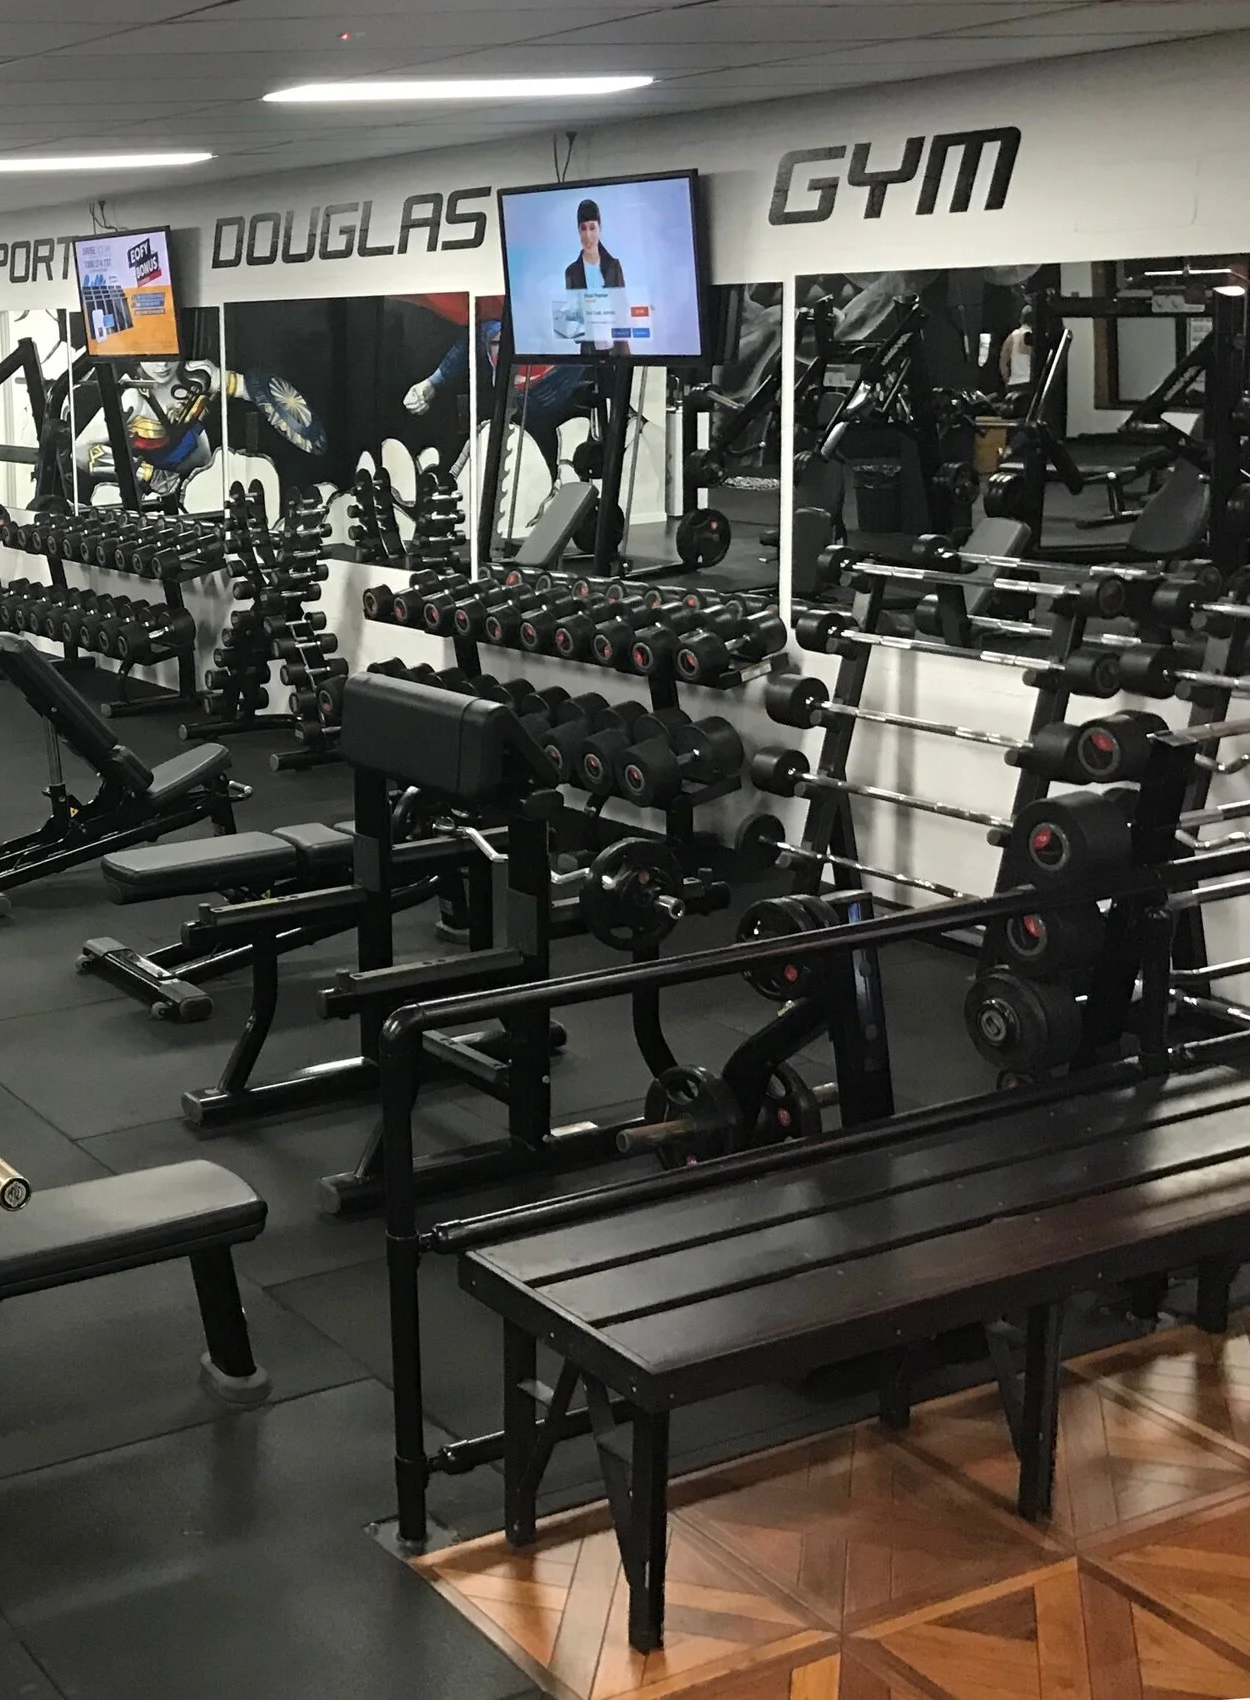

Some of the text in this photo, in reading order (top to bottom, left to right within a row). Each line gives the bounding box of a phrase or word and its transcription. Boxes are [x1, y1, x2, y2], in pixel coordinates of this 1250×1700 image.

[212, 186, 492, 269] DOUGLAS
[768, 125, 1021, 226] GYM
[130, 241, 149, 264] EOFY
[135, 256, 158, 280] BONUS
